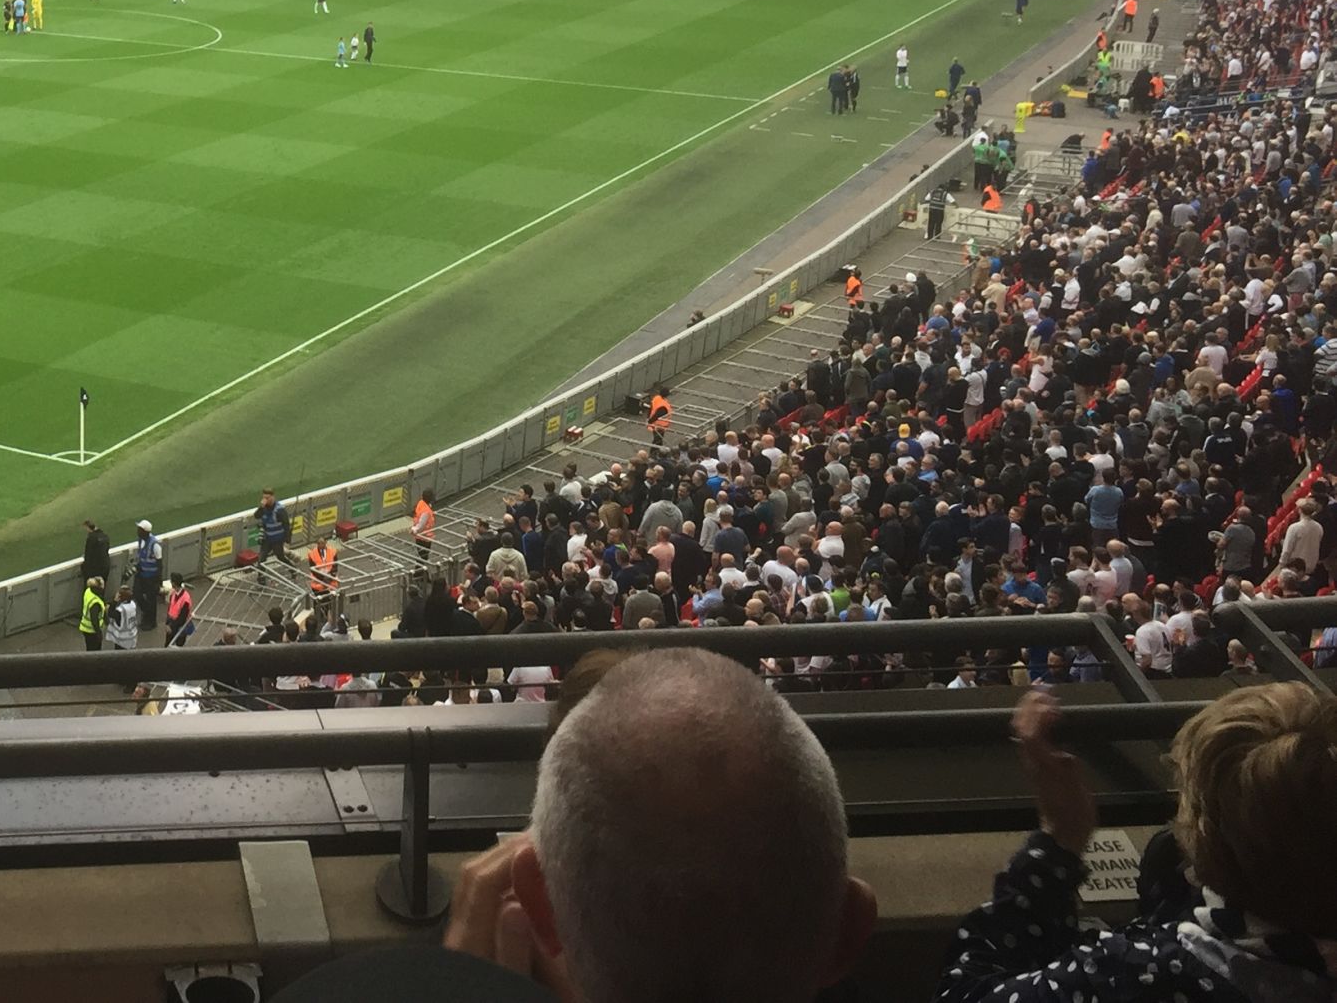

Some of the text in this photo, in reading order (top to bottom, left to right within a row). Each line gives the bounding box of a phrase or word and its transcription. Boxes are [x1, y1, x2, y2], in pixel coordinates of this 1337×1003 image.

[1085, 840, 1125, 854] EASE
[1088, 857, 1139, 873] MAIN
[1083, 877, 1138, 891] SEATE
